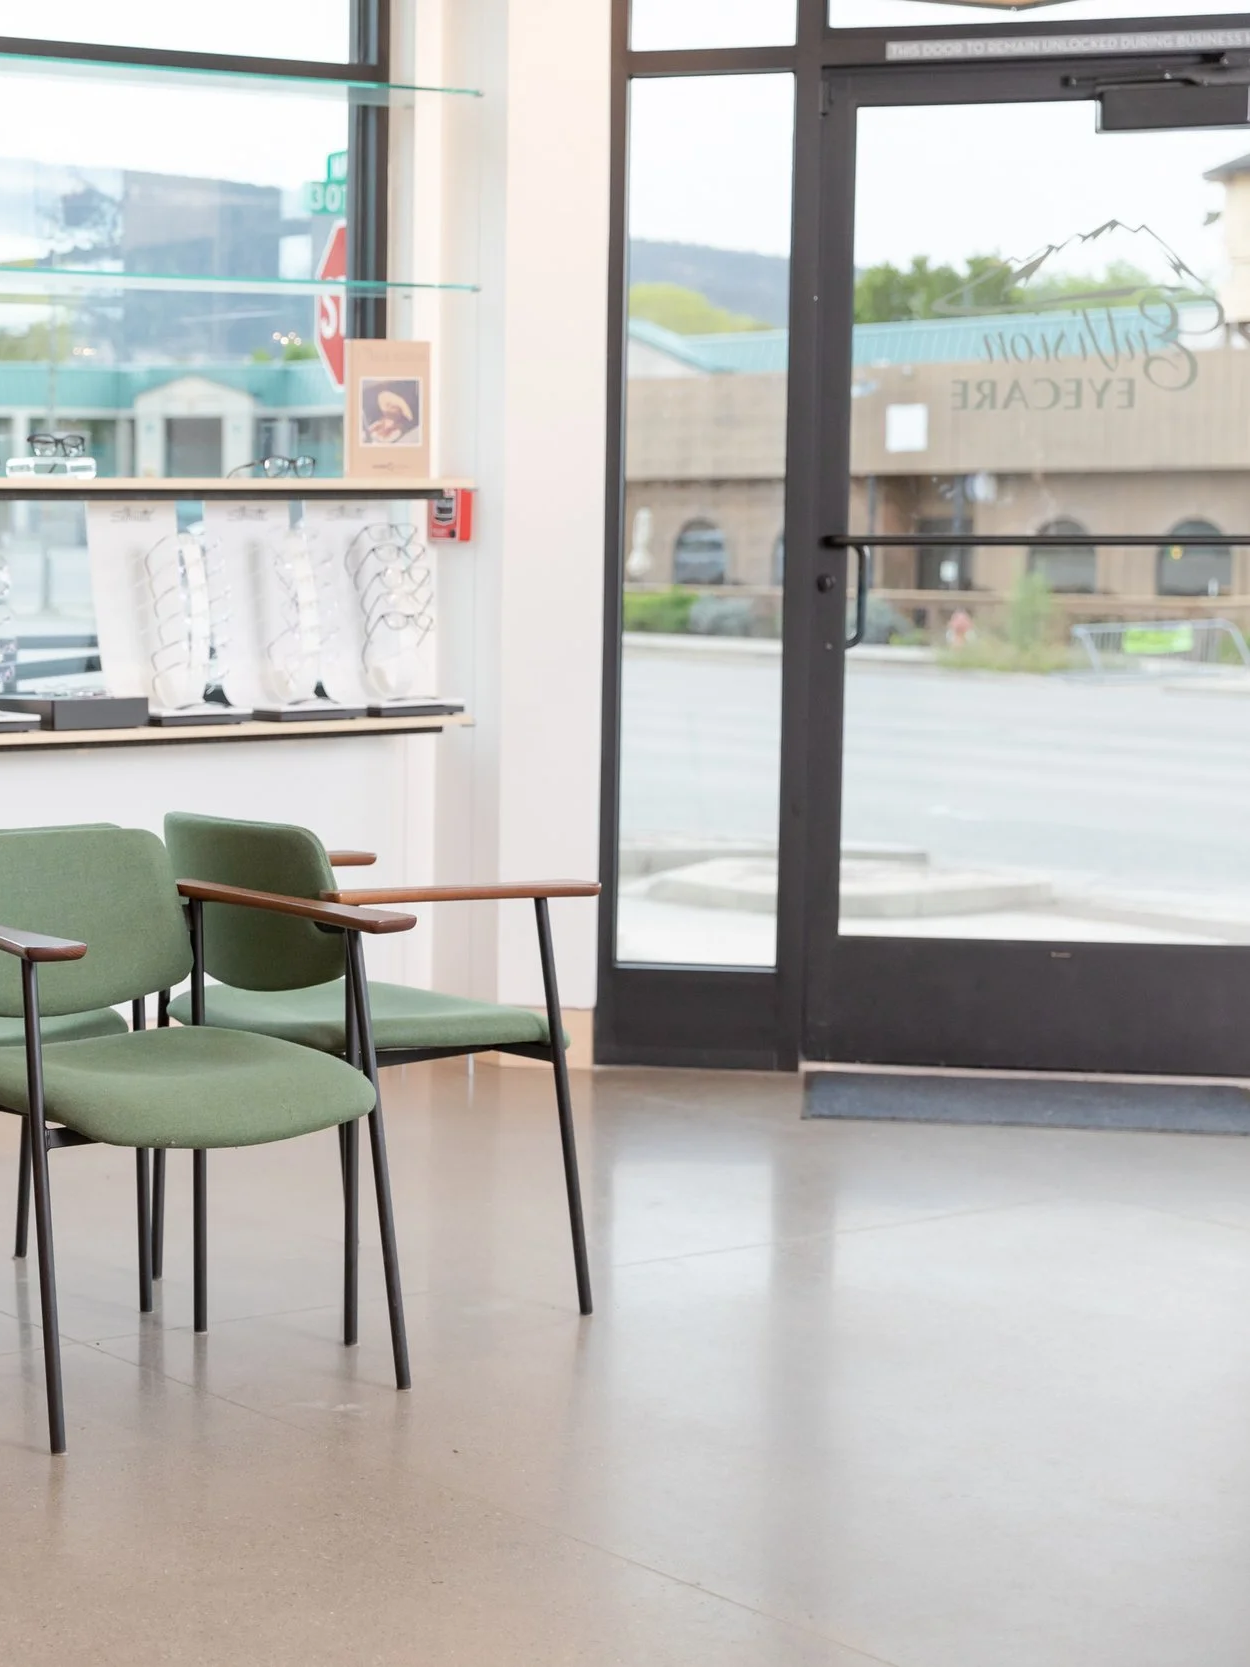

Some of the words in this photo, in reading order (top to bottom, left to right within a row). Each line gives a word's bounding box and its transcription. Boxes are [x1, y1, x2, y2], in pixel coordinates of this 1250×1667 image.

[891, 43, 920, 57] THIS
[923, 42, 963, 56] DOOR
[966, 41, 985, 55] TO
[988, 38, 1040, 54] REMAIN
[1042, 36, 1118, 52] UNLOCKED
[1121, 34, 1173, 49] DURING
[1176, 31, 1242, 48] BUSINESS
